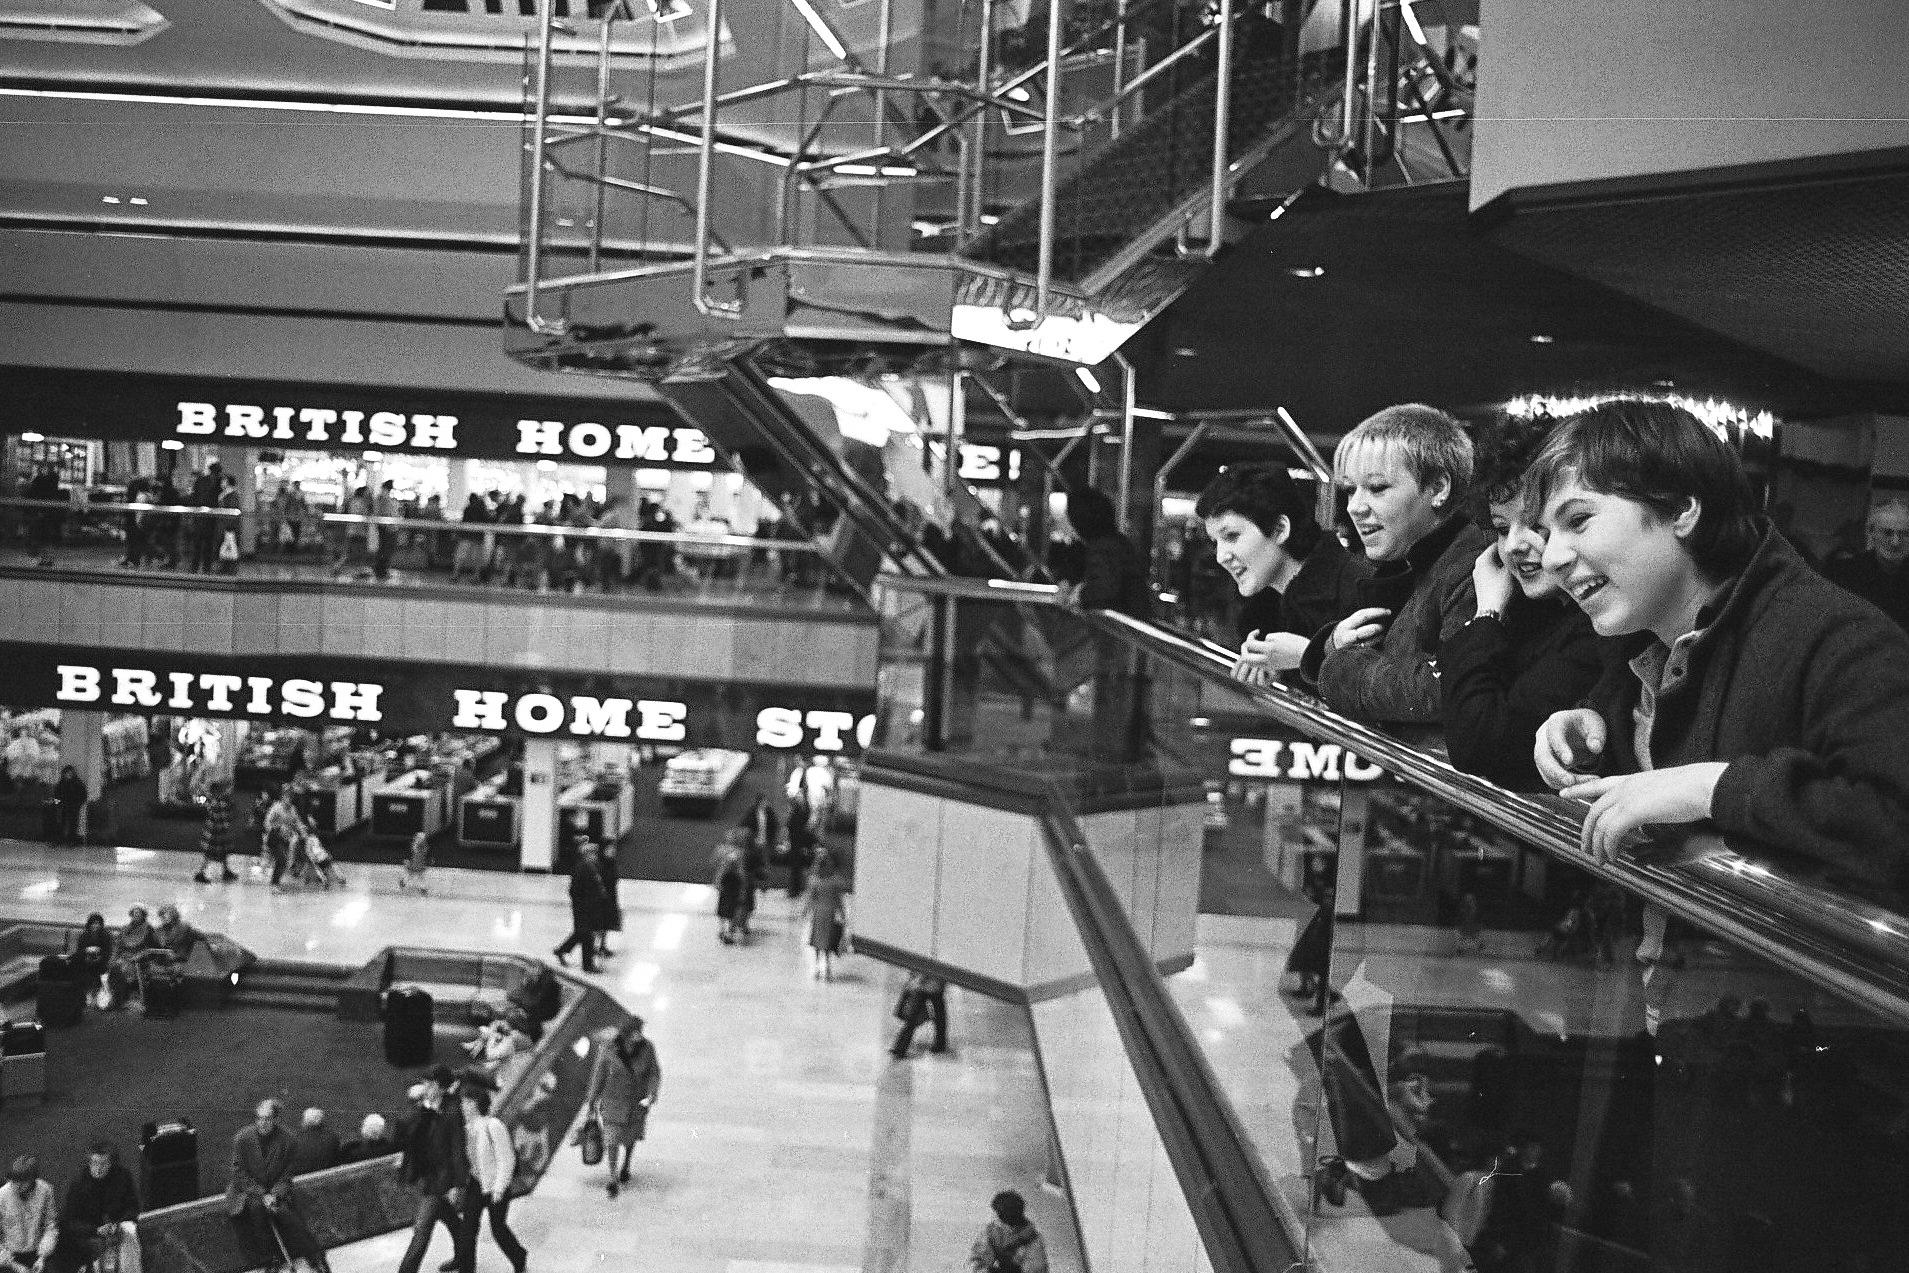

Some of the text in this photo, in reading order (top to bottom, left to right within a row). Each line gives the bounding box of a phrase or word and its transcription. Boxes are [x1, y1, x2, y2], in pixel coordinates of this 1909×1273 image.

[176, 401, 715, 464] BRITISH HOME
[56, 665, 383, 722] BRITISH
[452, 689, 687, 741] HOME
